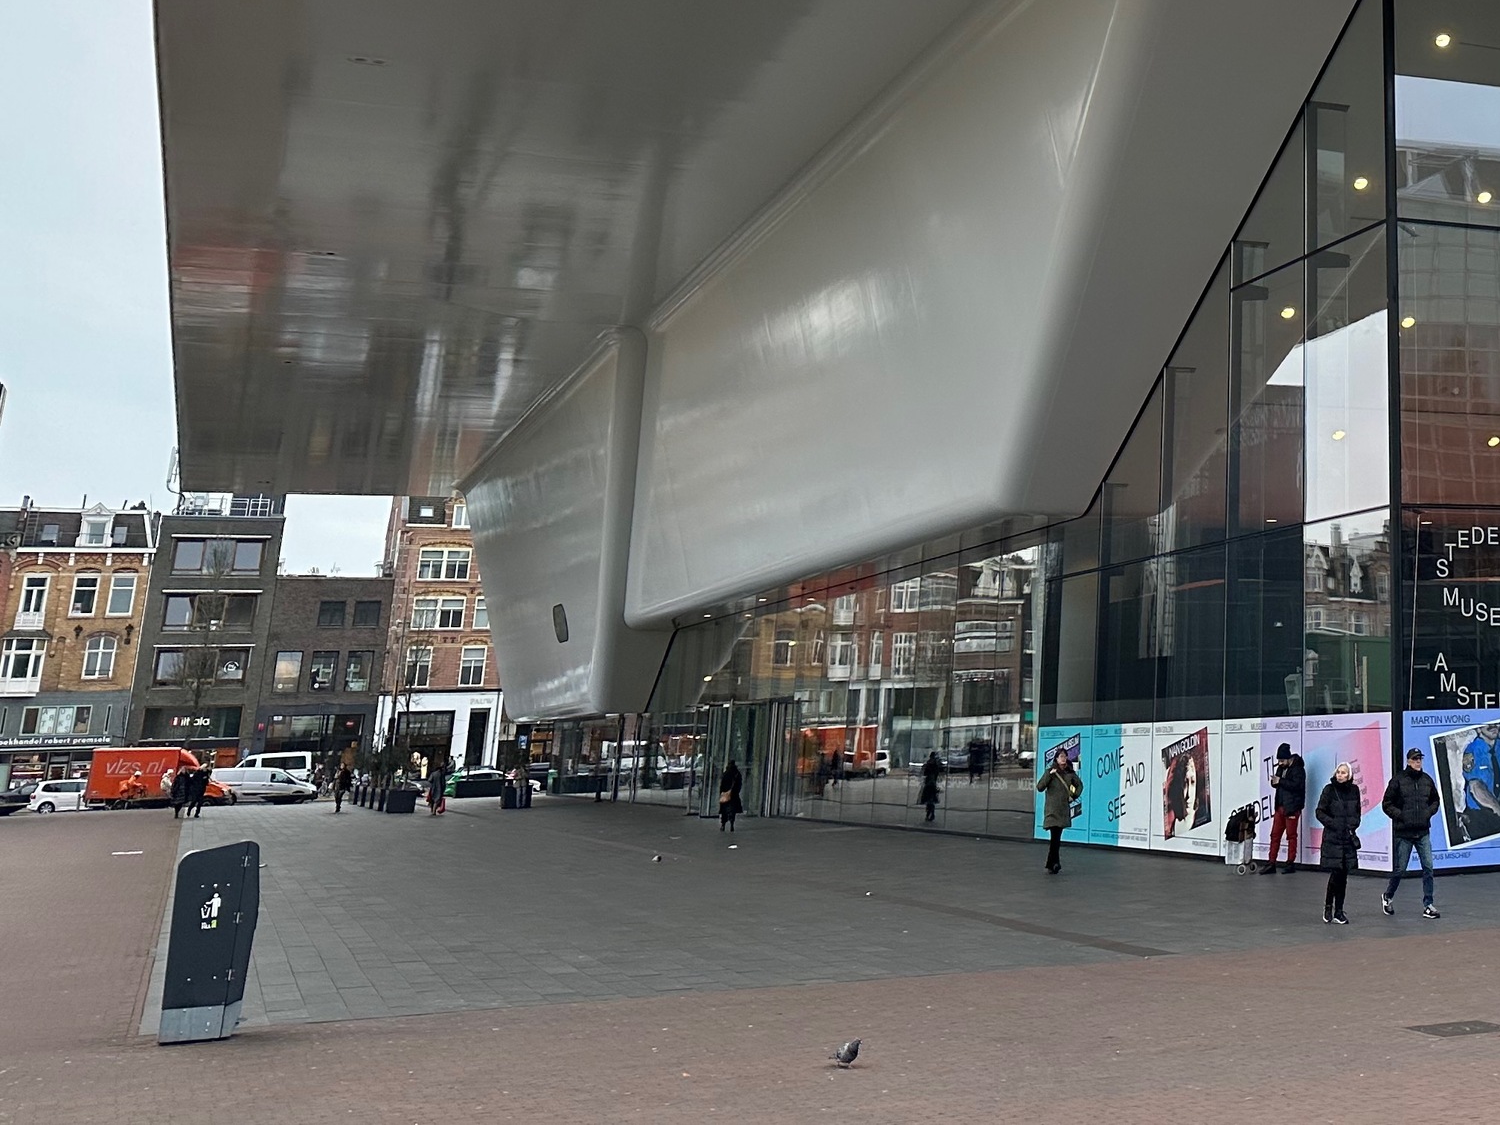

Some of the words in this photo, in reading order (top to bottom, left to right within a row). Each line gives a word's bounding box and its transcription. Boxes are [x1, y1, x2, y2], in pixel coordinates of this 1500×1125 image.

[1411, 716, 1444, 725] MARTIN
[1444, 715, 1471, 724] WONG
[1169, 743, 1181, 758] NAN
[1180, 734, 1200, 753] GOLDIN
[106, 758, 166, 774] vlzs.nl
[1097, 746, 1125, 778] COME
[1124, 762, 1145, 789] AND
[1240, 746, 1254, 775] AT
[1263, 755, 1279, 781] TH
[1107, 794, 1126, 822] SEE
